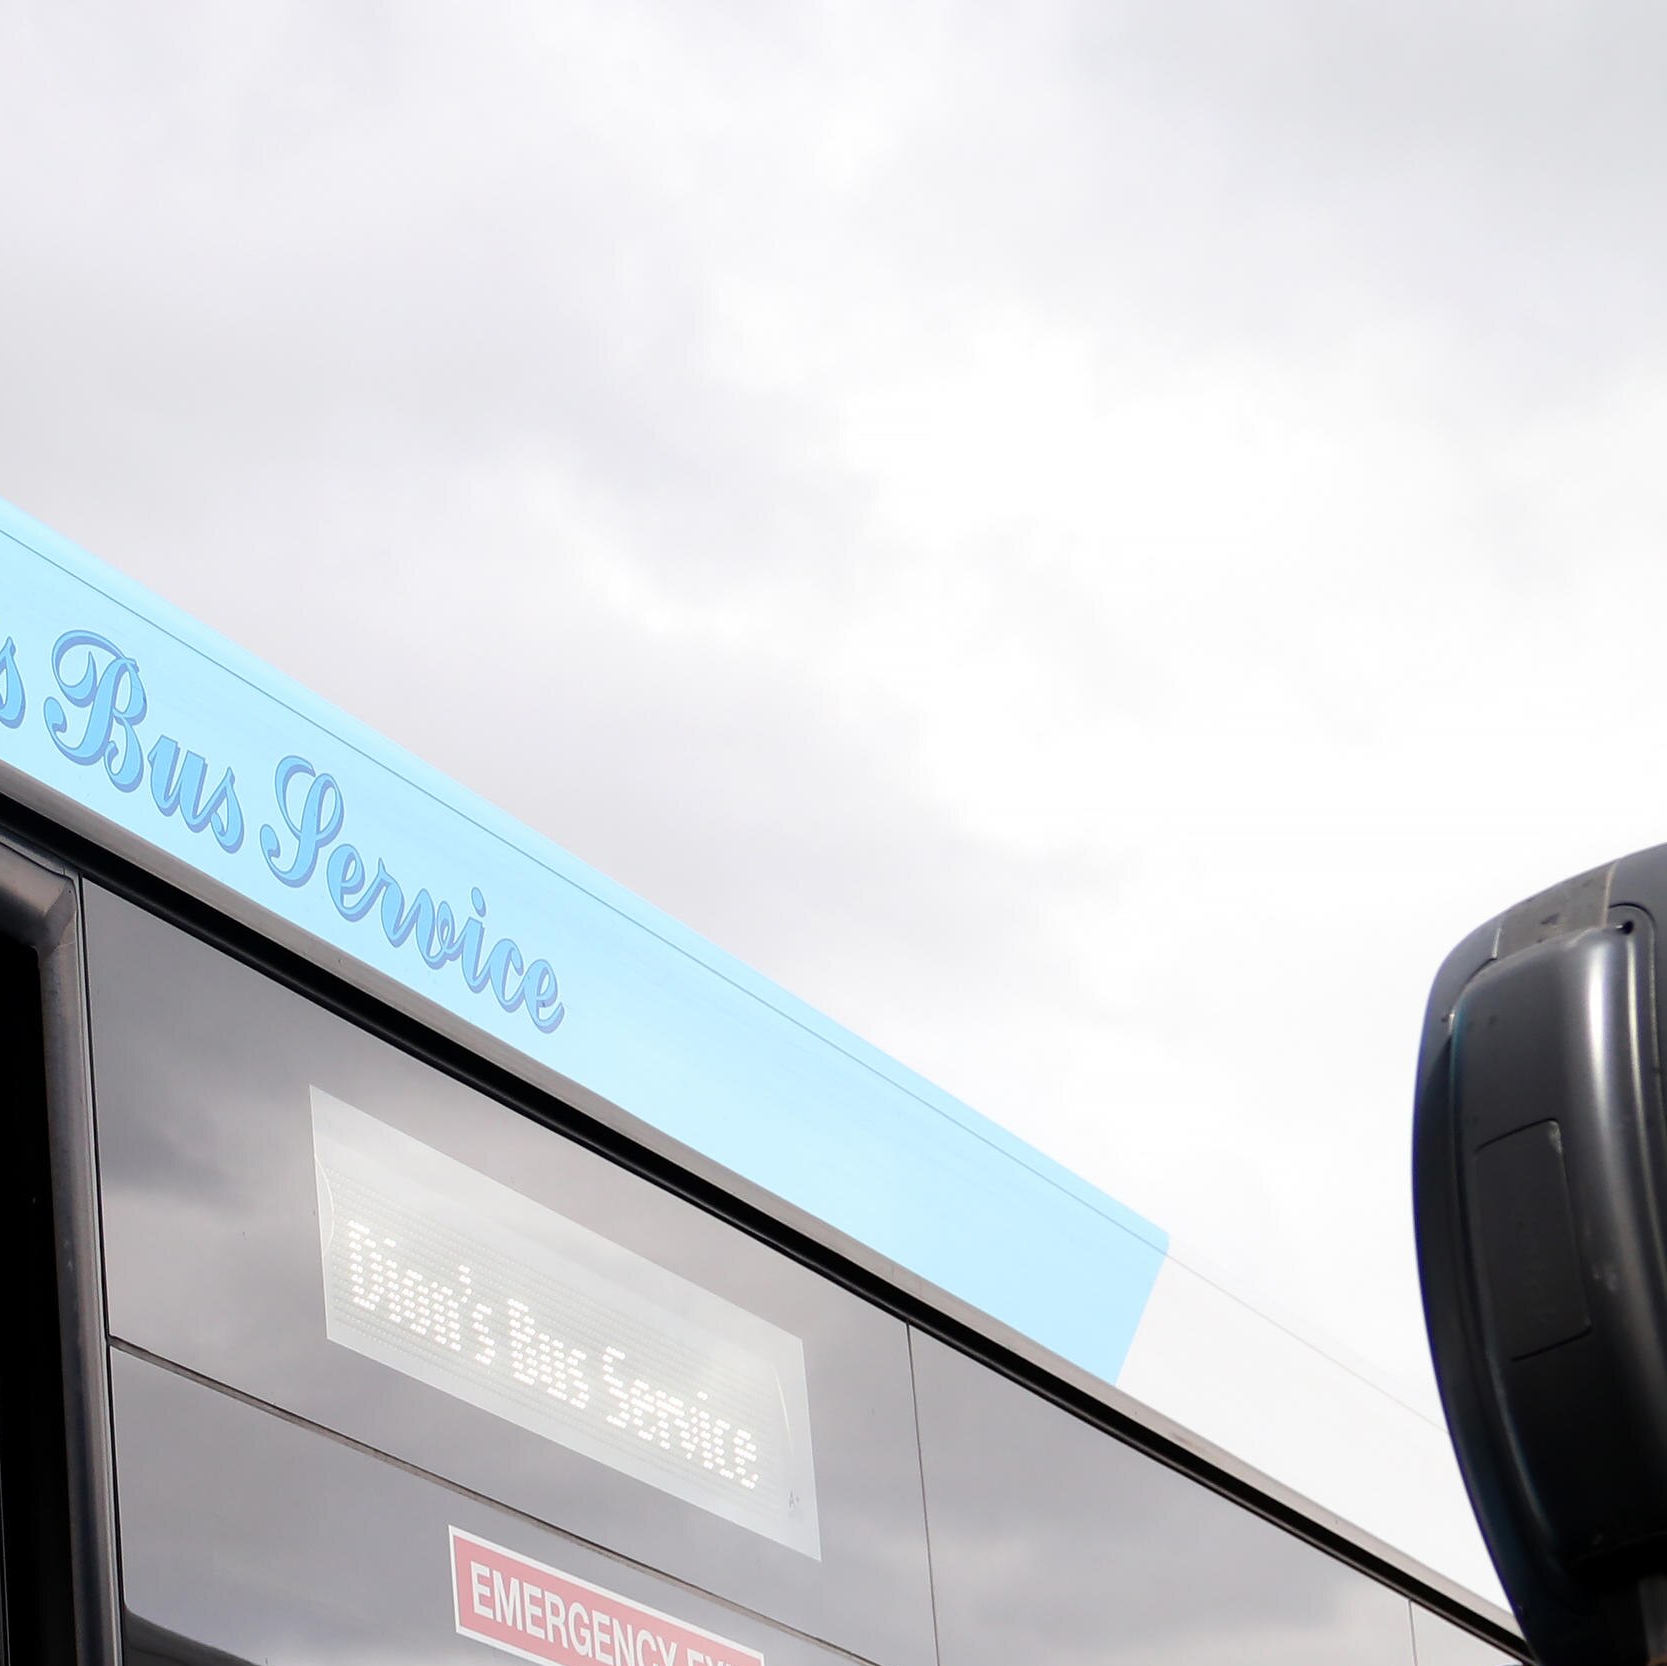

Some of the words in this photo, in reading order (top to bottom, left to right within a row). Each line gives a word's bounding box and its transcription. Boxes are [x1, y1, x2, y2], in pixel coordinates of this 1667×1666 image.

[42, 629, 244, 852] Bus
[259, 755, 565, 1034] Service
[347, 1220, 496, 1365] Dion's
[508, 1298, 590, 1409] Bus
[602, 1345, 759, 1489] Service
